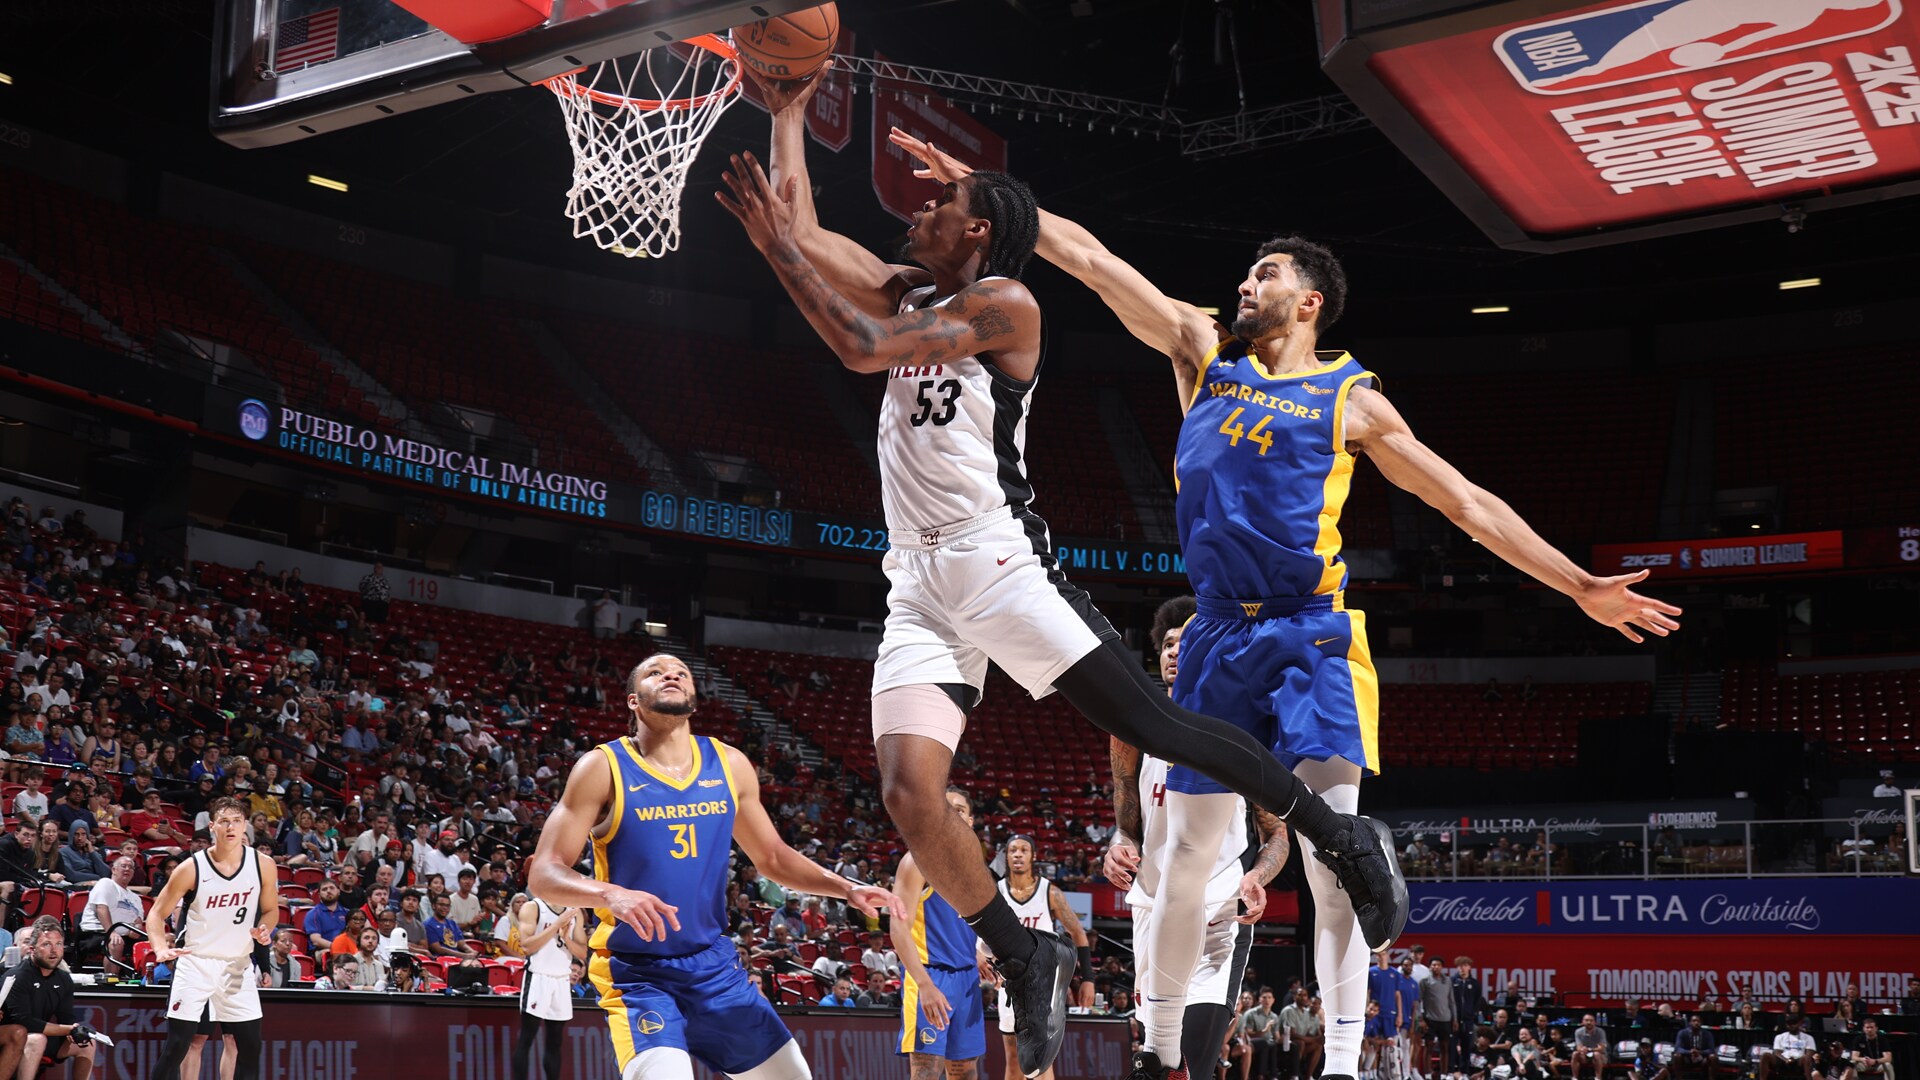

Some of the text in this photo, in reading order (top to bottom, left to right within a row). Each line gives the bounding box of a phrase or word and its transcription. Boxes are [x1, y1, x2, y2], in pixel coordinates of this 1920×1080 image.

[1518, 31, 1590, 72] NBA
[1845, 45, 1920, 128] 2K25
[1550, 87, 1737, 195] LEAGUE
[1690, 61, 1879, 188] SUMMER
[910, 379, 962, 427] 53
[1209, 382, 1322, 420] WARRIORS
[1301, 381, 1334, 395] Rakuten
[240, 412, 267, 433] PMI
[1218, 406, 1275, 456] 44
[279, 407, 608, 501] PUEBLO MEDICAL IMAGING
[279, 431, 606, 518] OFFICIAL PARTNER OF UNLV ATHLETICS
[641, 491, 792, 546] GO REBELS!
[817, 523, 892, 551] 702.22
[1621, 542, 1808, 568] 2K25 SUMMER LEAGUE
[1058, 547, 1187, 573] PMILV.COM
[407, 577, 438, 601] 119
[635, 800, 728, 821] WARRIORS
[1473, 818, 1537, 834] ULTRA
[1657, 812, 1718, 829] EXPERIENCES
[668, 823, 698, 859] 31
[206, 887, 254, 909] HEAT
[232, 906, 248, 925] 9
[1409, 893, 1821, 931] Michelob ULTRA Courtside
[1588, 968, 1718, 1001] TOMORROW'S
[1726, 970, 1791, 1002] STARS
[1799, 971, 1850, 1003] PLAY
[1858, 972, 1914, 1004] HERE
